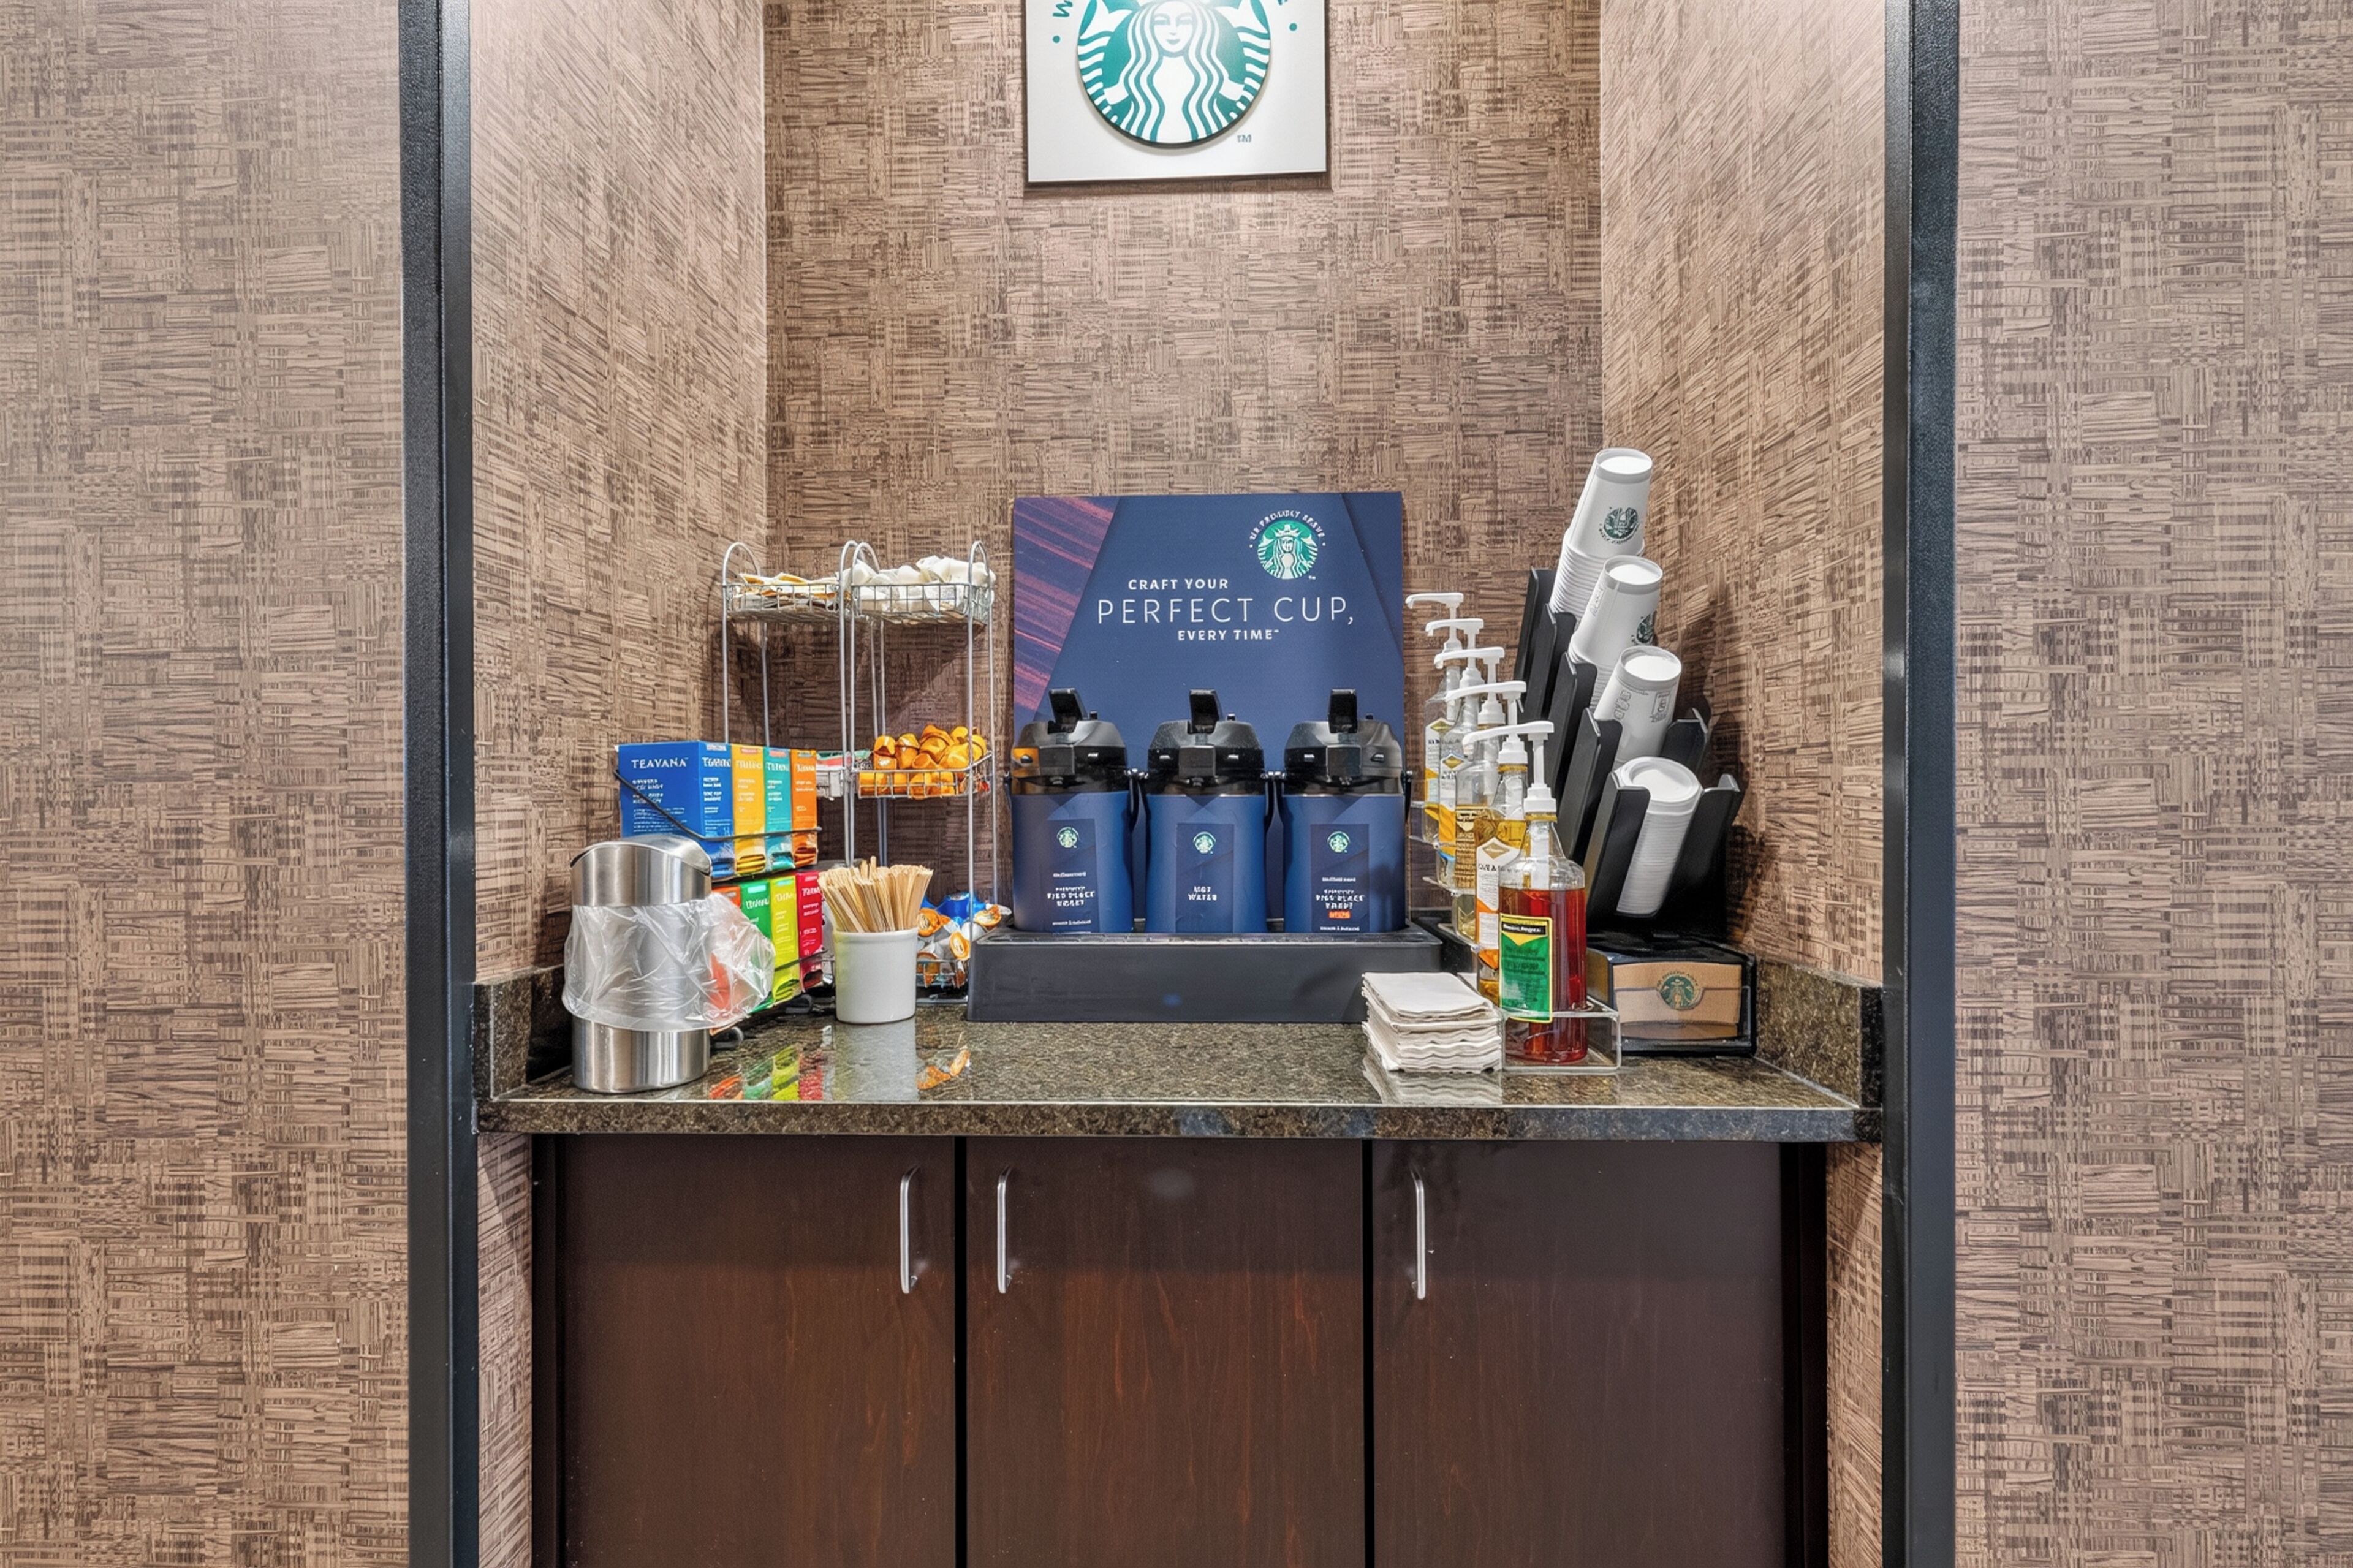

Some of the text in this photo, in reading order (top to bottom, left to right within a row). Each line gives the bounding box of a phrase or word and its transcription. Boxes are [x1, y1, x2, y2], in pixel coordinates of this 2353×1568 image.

[1128, 578, 1228, 590] CRAFT YOUR
[1098, 597, 1353, 625] PERFECT CUP,
[1178, 630, 1227, 641] EVERY
[631, 758, 687, 769] TEAVANA
